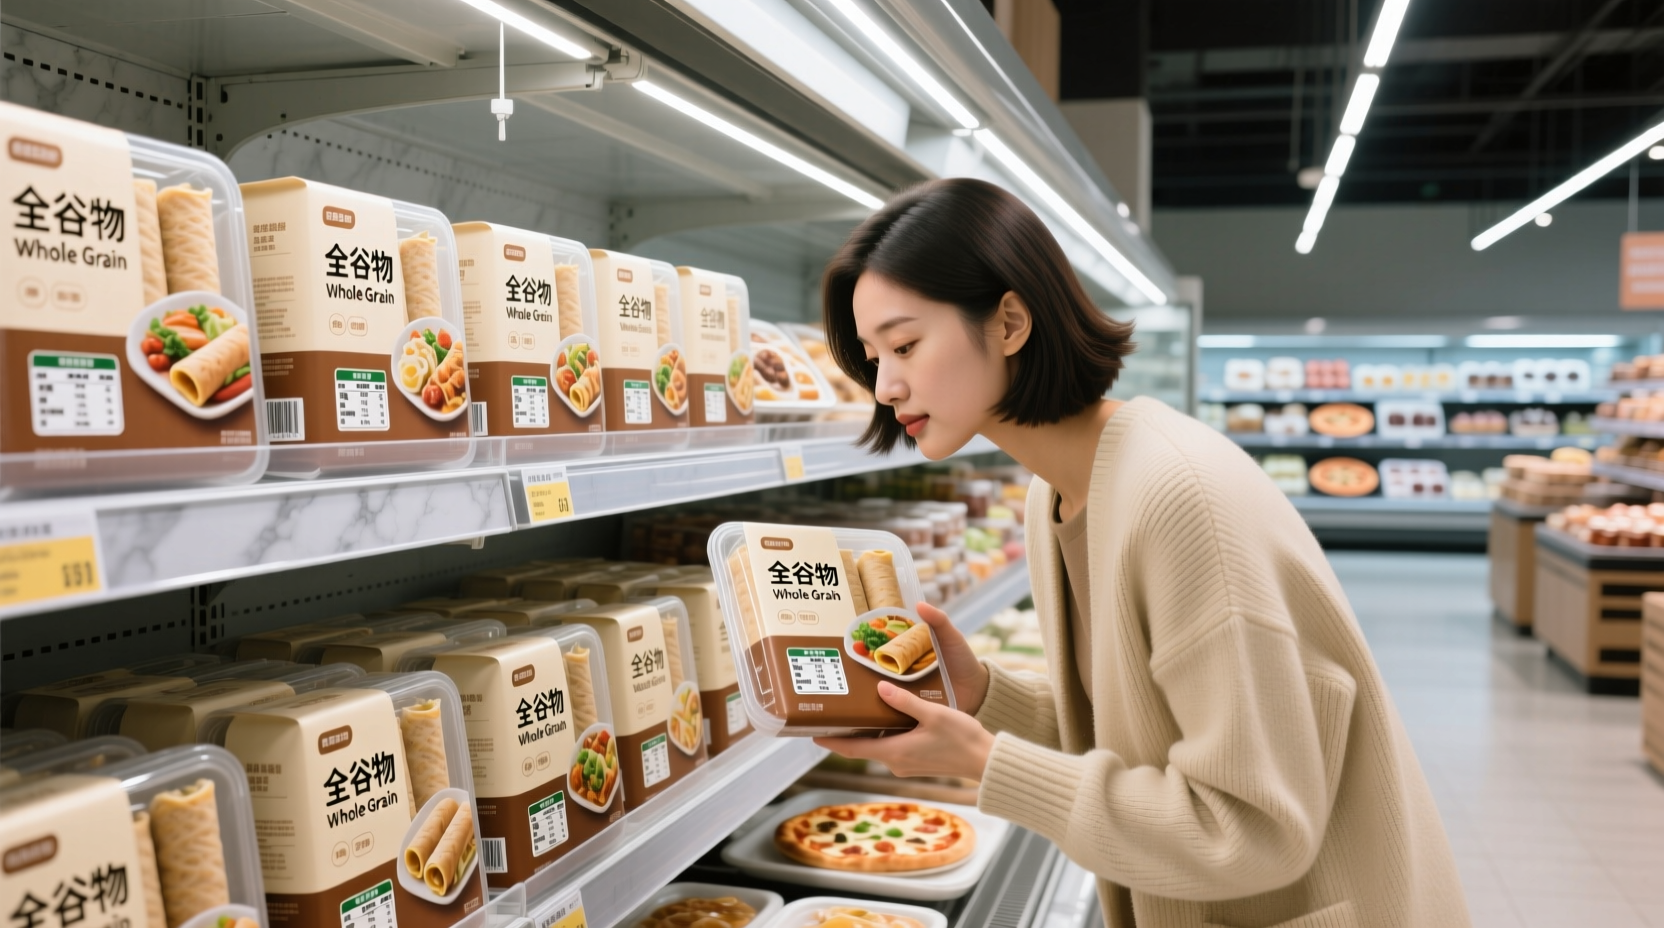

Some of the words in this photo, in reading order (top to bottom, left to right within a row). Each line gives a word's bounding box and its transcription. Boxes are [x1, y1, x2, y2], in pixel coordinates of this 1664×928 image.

[13, 186, 125, 243] 全谷物
[14, 238, 78, 264] Whole
[82, 246, 128, 270] Grain
[325, 242, 393, 284] 全谷物
[326, 283, 363, 301] Whole
[365, 287, 395, 305] Grain
[505, 274, 552, 307] 全谷物
[767, 560, 839, 587] 全谷物
[772, 588, 809, 600] Whole
[515, 687, 564, 729] 全谷物
[323, 751, 396, 807] 全谷物
[326, 802, 367, 829] Whole
[367, 790, 398, 813] Grain
[9, 862, 128, 928] 全谷物
